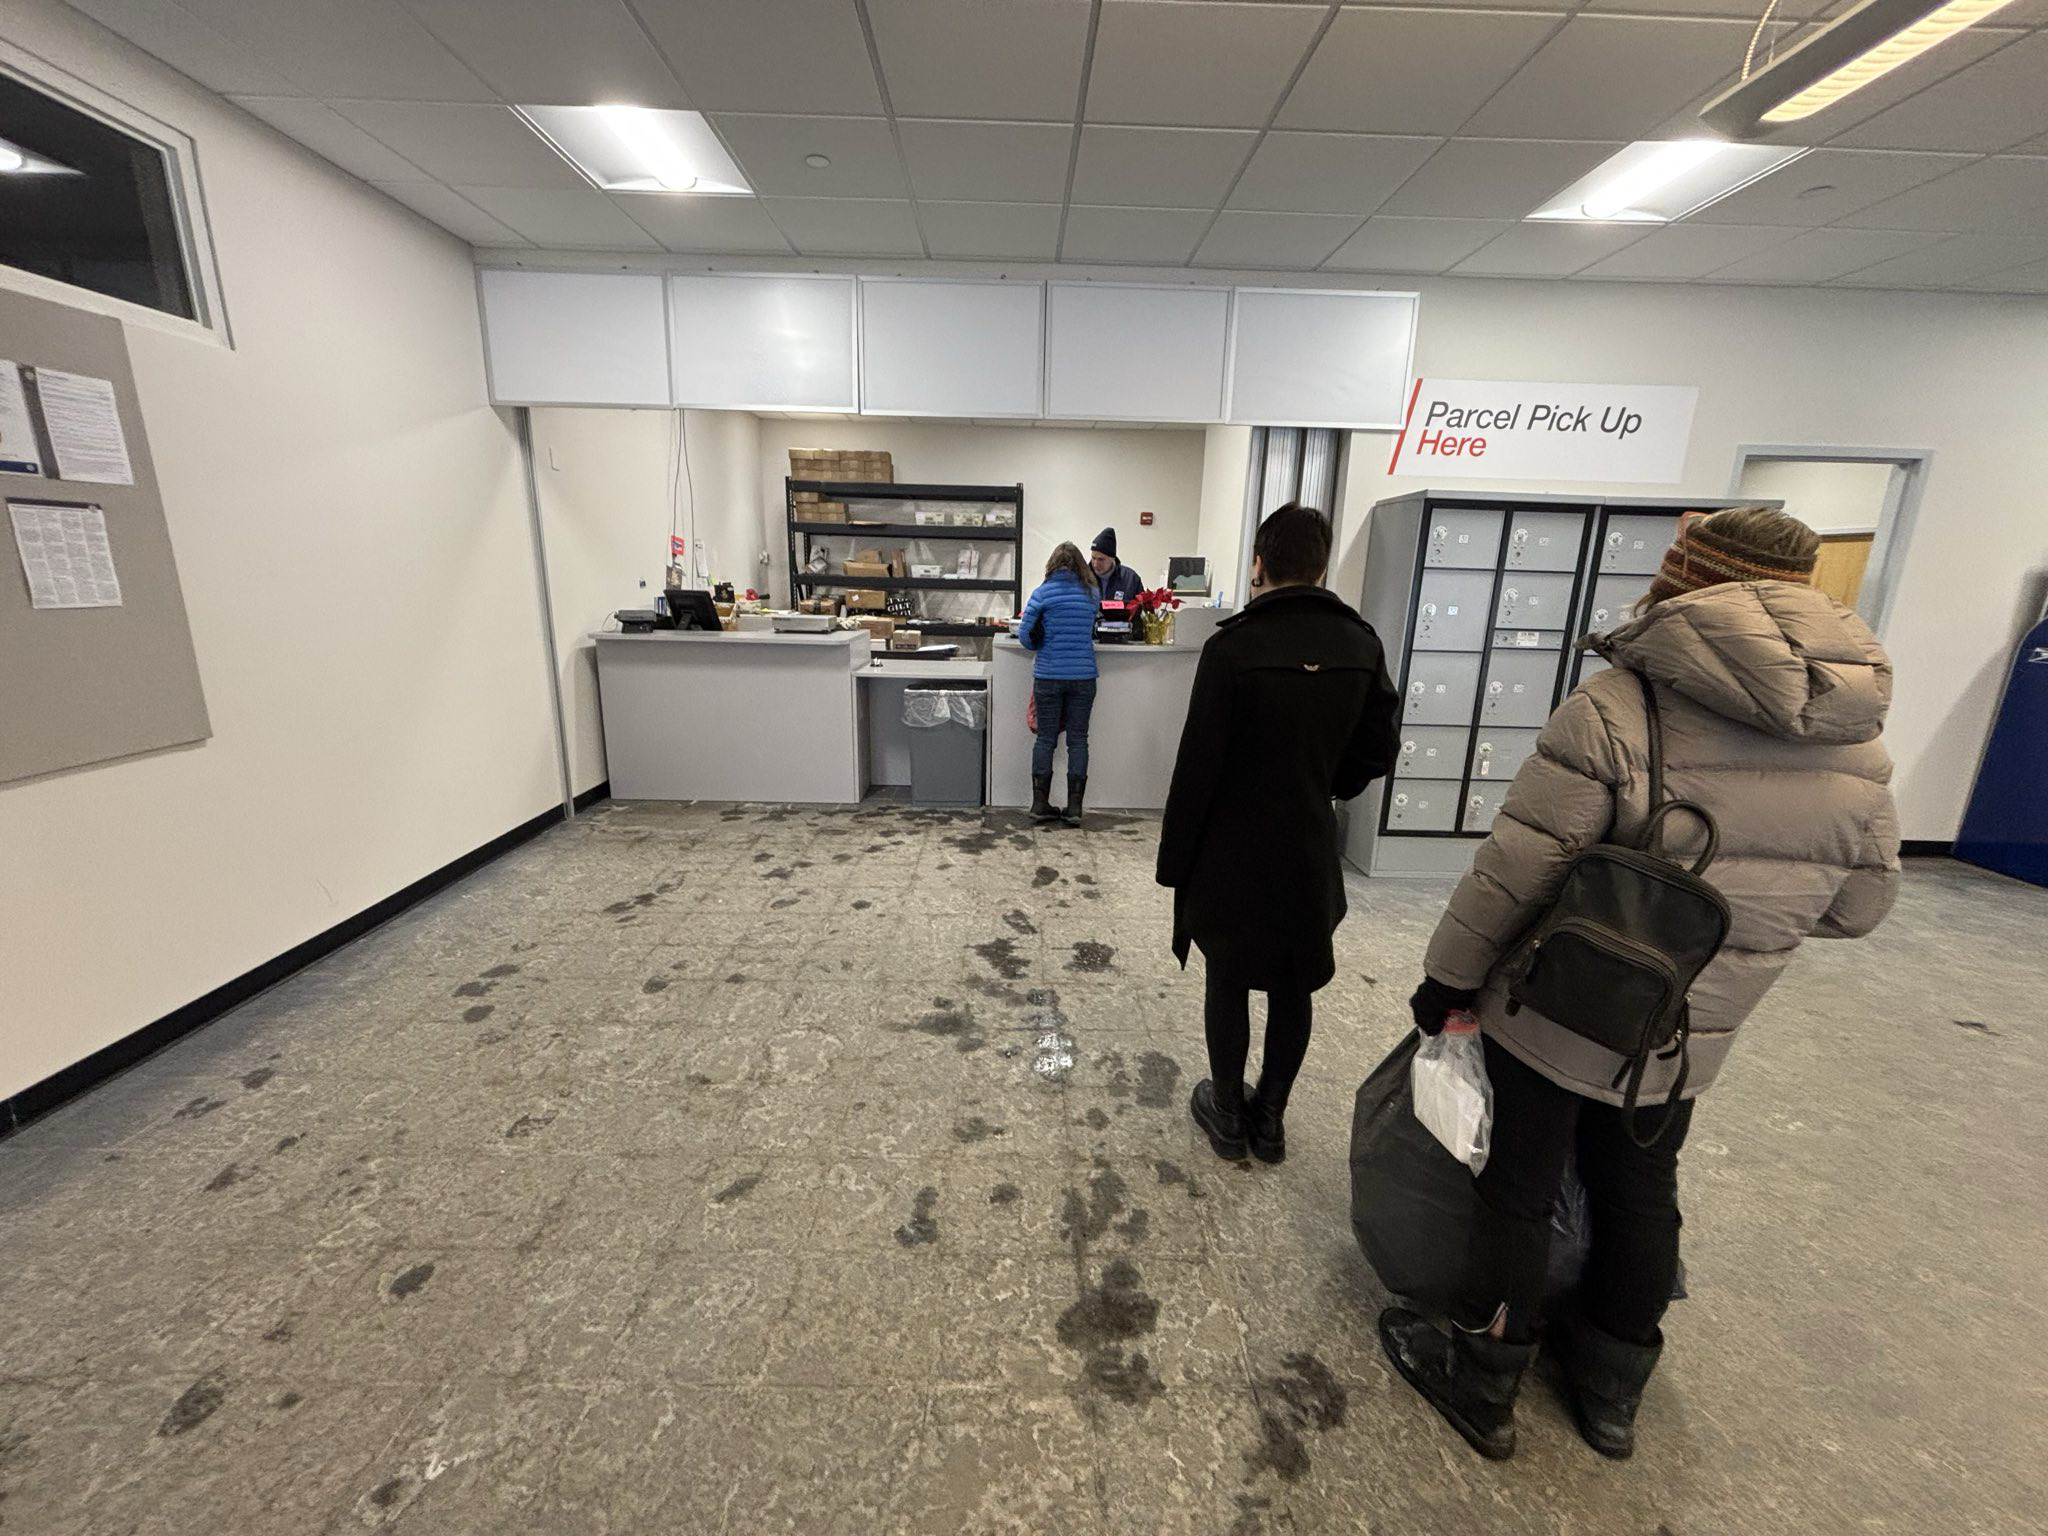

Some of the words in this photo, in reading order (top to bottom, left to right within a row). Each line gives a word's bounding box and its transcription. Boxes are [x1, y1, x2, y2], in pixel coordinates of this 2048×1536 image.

[1425, 400, 1521, 430] Parcel
[1527, 405, 1592, 432] Pick
[1600, 407, 1643, 440] Up
[1416, 429, 1487, 457] Here
